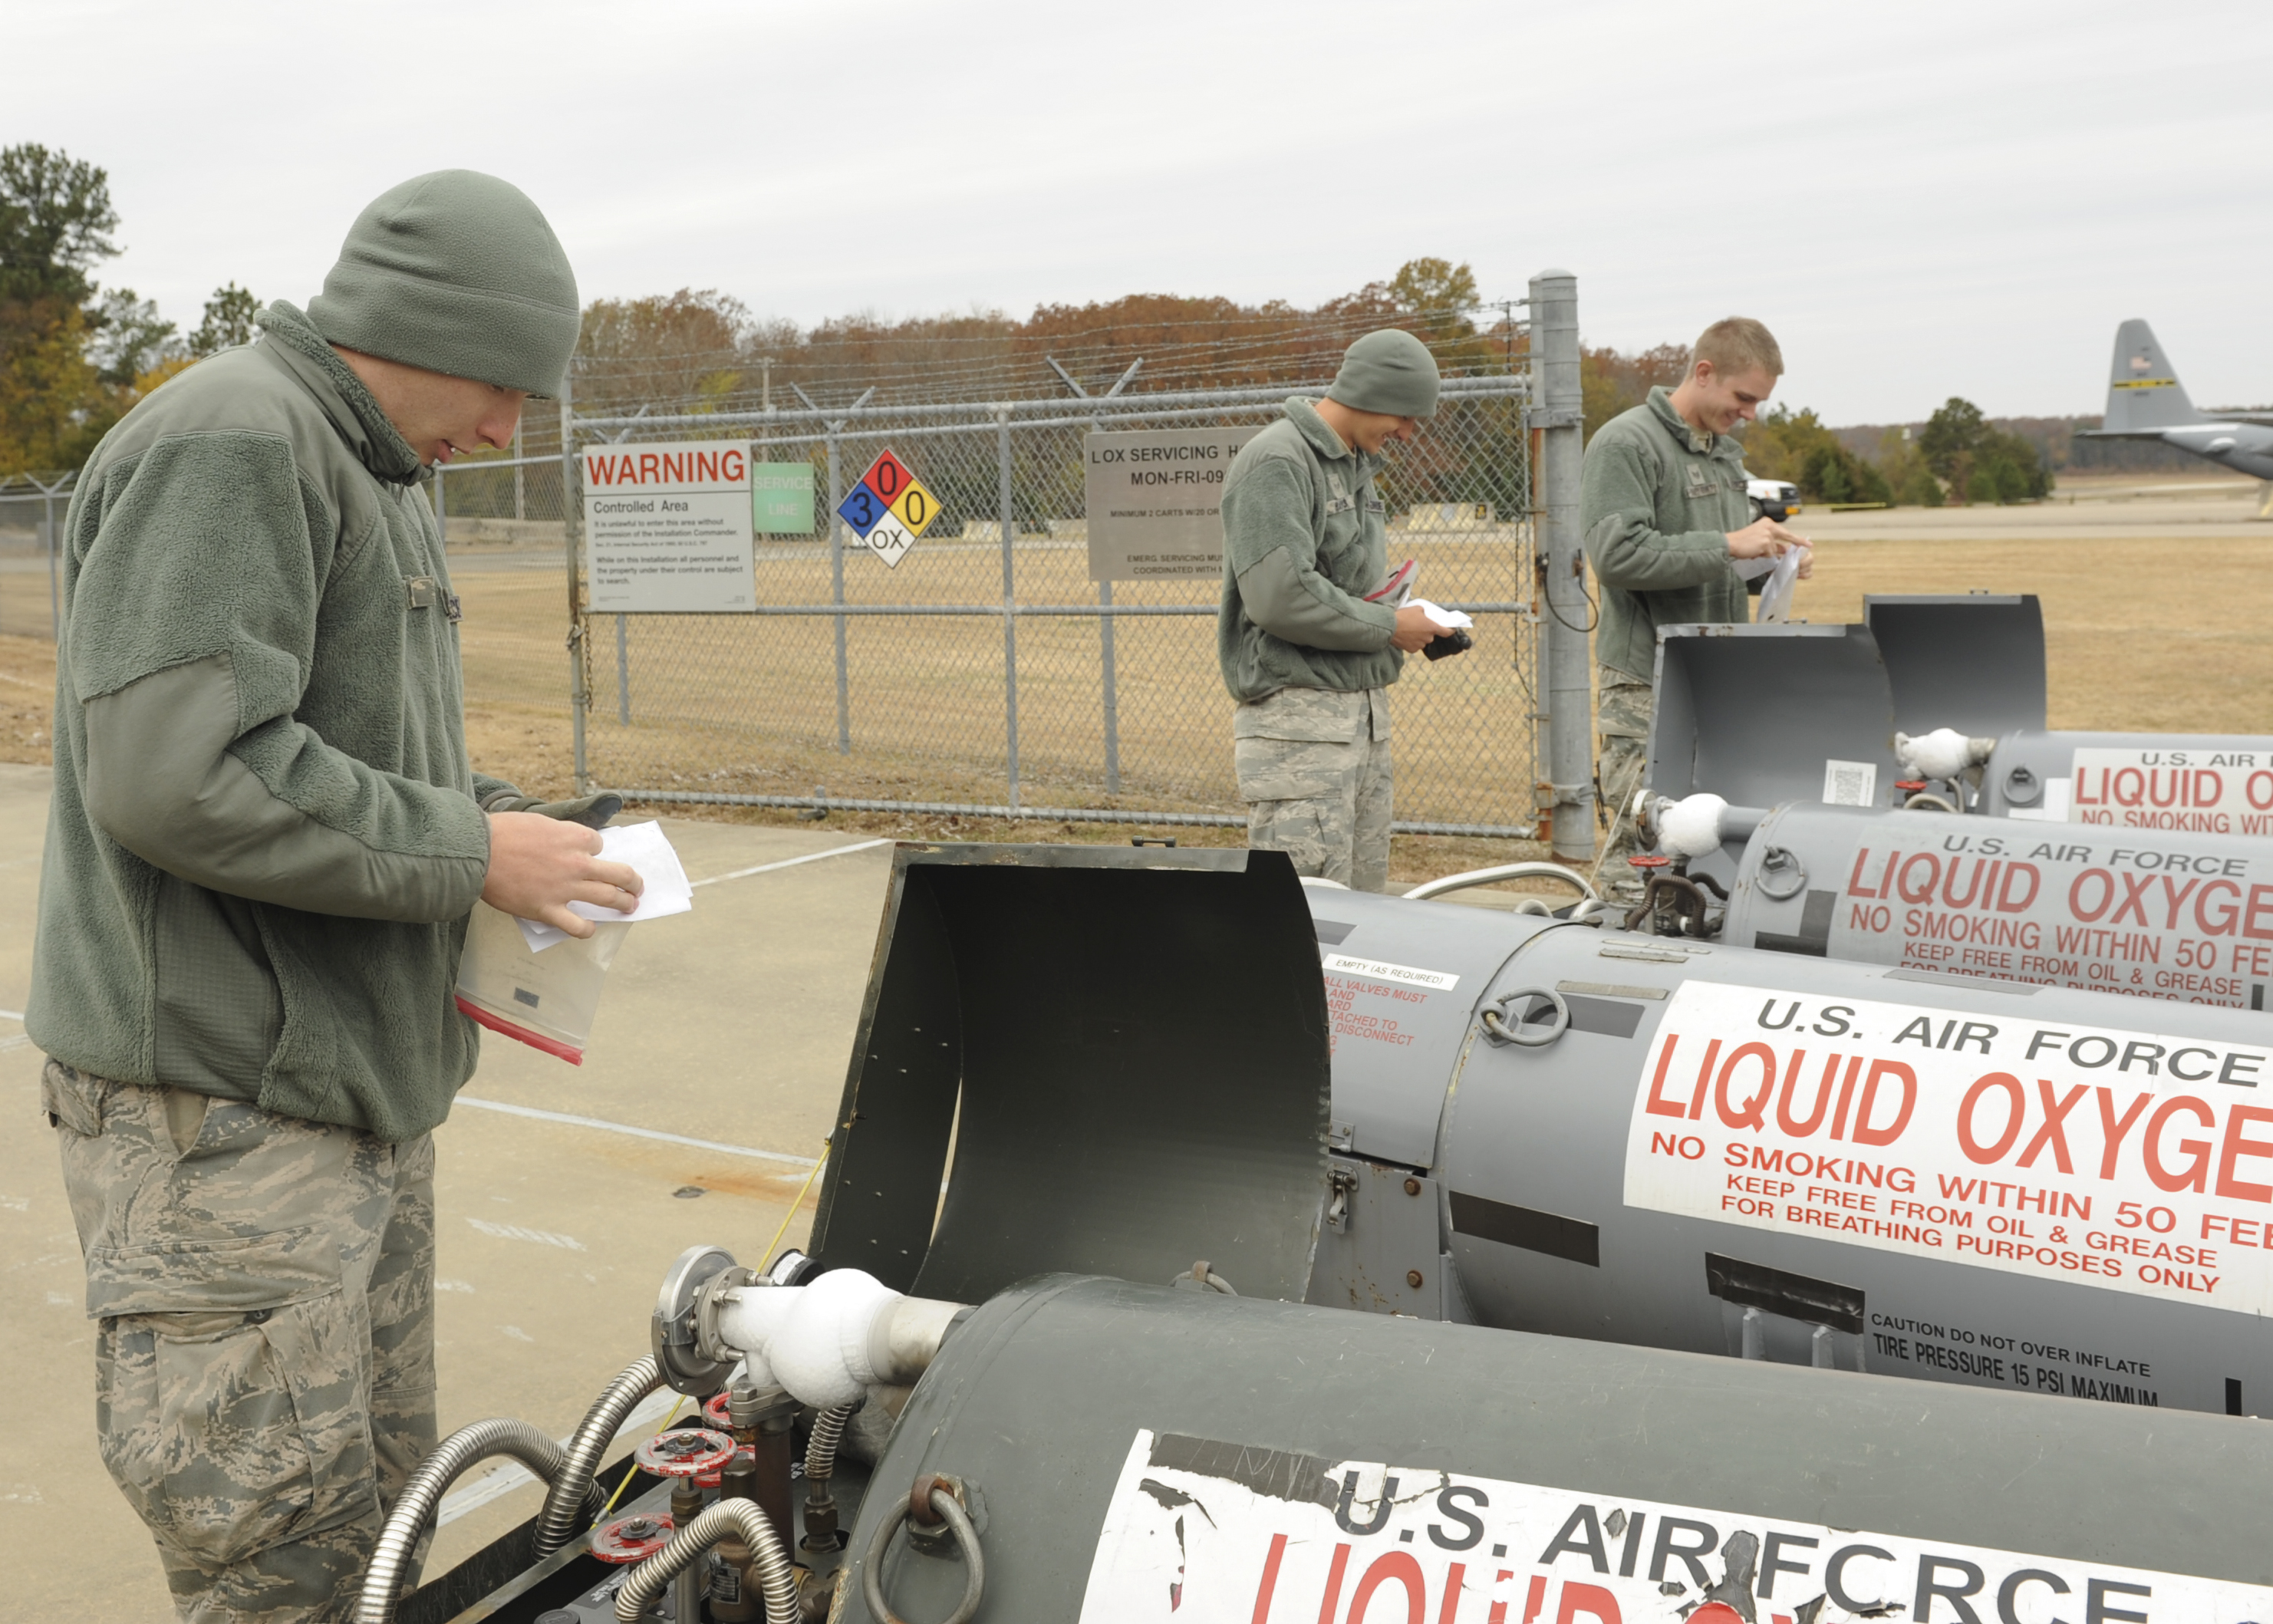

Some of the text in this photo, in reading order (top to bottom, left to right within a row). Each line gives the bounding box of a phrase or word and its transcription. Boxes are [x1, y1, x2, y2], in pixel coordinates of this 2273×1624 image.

[1092, 445, 1244, 463] LOX SERVICING H
[587, 450, 745, 486] WARNING
[878, 461, 898, 496] 0
[1132, 470, 1225, 485] MON-FRI-09
[753, 476, 813, 490] SERVICE
[594, 499, 688, 513] Controlled Area
[768, 503, 799, 516] LINE
[852, 492, 873, 528] 3
[905, 490, 925, 525] 0
[595, 531, 631, 539] permission
[872, 529, 904, 550] OX
[609, 567, 637, 575] property
[677, 565, 703, 574] control
[717, 565, 743, 575] subject
[689, 555, 723, 564] personnel
[1133, 566, 1193, 575] COORDINATED
[1160, 554, 1205, 562] SERVICING
[2140, 752, 2195, 766] U.S.
[2209, 753, 2255, 767] AIR
[2076, 766, 2223, 808] LIQUID
[2124, 810, 2230, 833] SMOKING
[1943, 835, 2249, 878] U.S. AIR FORCE
[1847, 848, 2041, 914] LIQUID
[1850, 903, 1891, 933] NO
[1904, 909, 2041, 950] SMOKING
[2056, 925, 2161, 964] WITHIN
[2176, 939, 2217, 970] 50
[1336, 960, 1444, 985] EMPTY (AS REQUIRED)
[1904, 941, 1954, 961] KEEP
[1962, 948, 2011, 969] FREE
[2021, 955, 2078, 977] FROM
[2088, 963, 2120, 982] OIL
[2130, 967, 2143, 984] &
[2155, 970, 2242, 996] GREASE
[1323, 976, 1428, 1003] ALL VALVES MUST
[1329, 989, 1356, 1000] AND
[1329, 1010, 1378, 1027] TACHED
[1382, 1020, 1398, 1031] TO
[1335, 1023, 1414, 1046] DISCONNECT
[1757, 998, 2266, 1088] U.S. AIR FORCE
[1645, 1033, 1918, 1146] LIQUID
[1650, 1132, 1705, 1160] NO
[1724, 1142, 1916, 1194] SMOKING
[1938, 1173, 2092, 1221] WITHIN
[2115, 1201, 2176, 1234] 50
[1727, 1174, 2218, 1269] KEEP FREE FROM OIL & GREASE
[1721, 1195, 2220, 1293] FOR BREATHING PURPOSES ONLY
[1871, 1313, 2151, 1378] CAUTION DO NOT OVER INFLATE
[1873, 1332, 2158, 1407] TIRE PRESSURE 15 PSI MAXIMUM
[1334, 1471, 1507, 1558] U.S.
[1537, 1504, 1719, 1590] AIR
